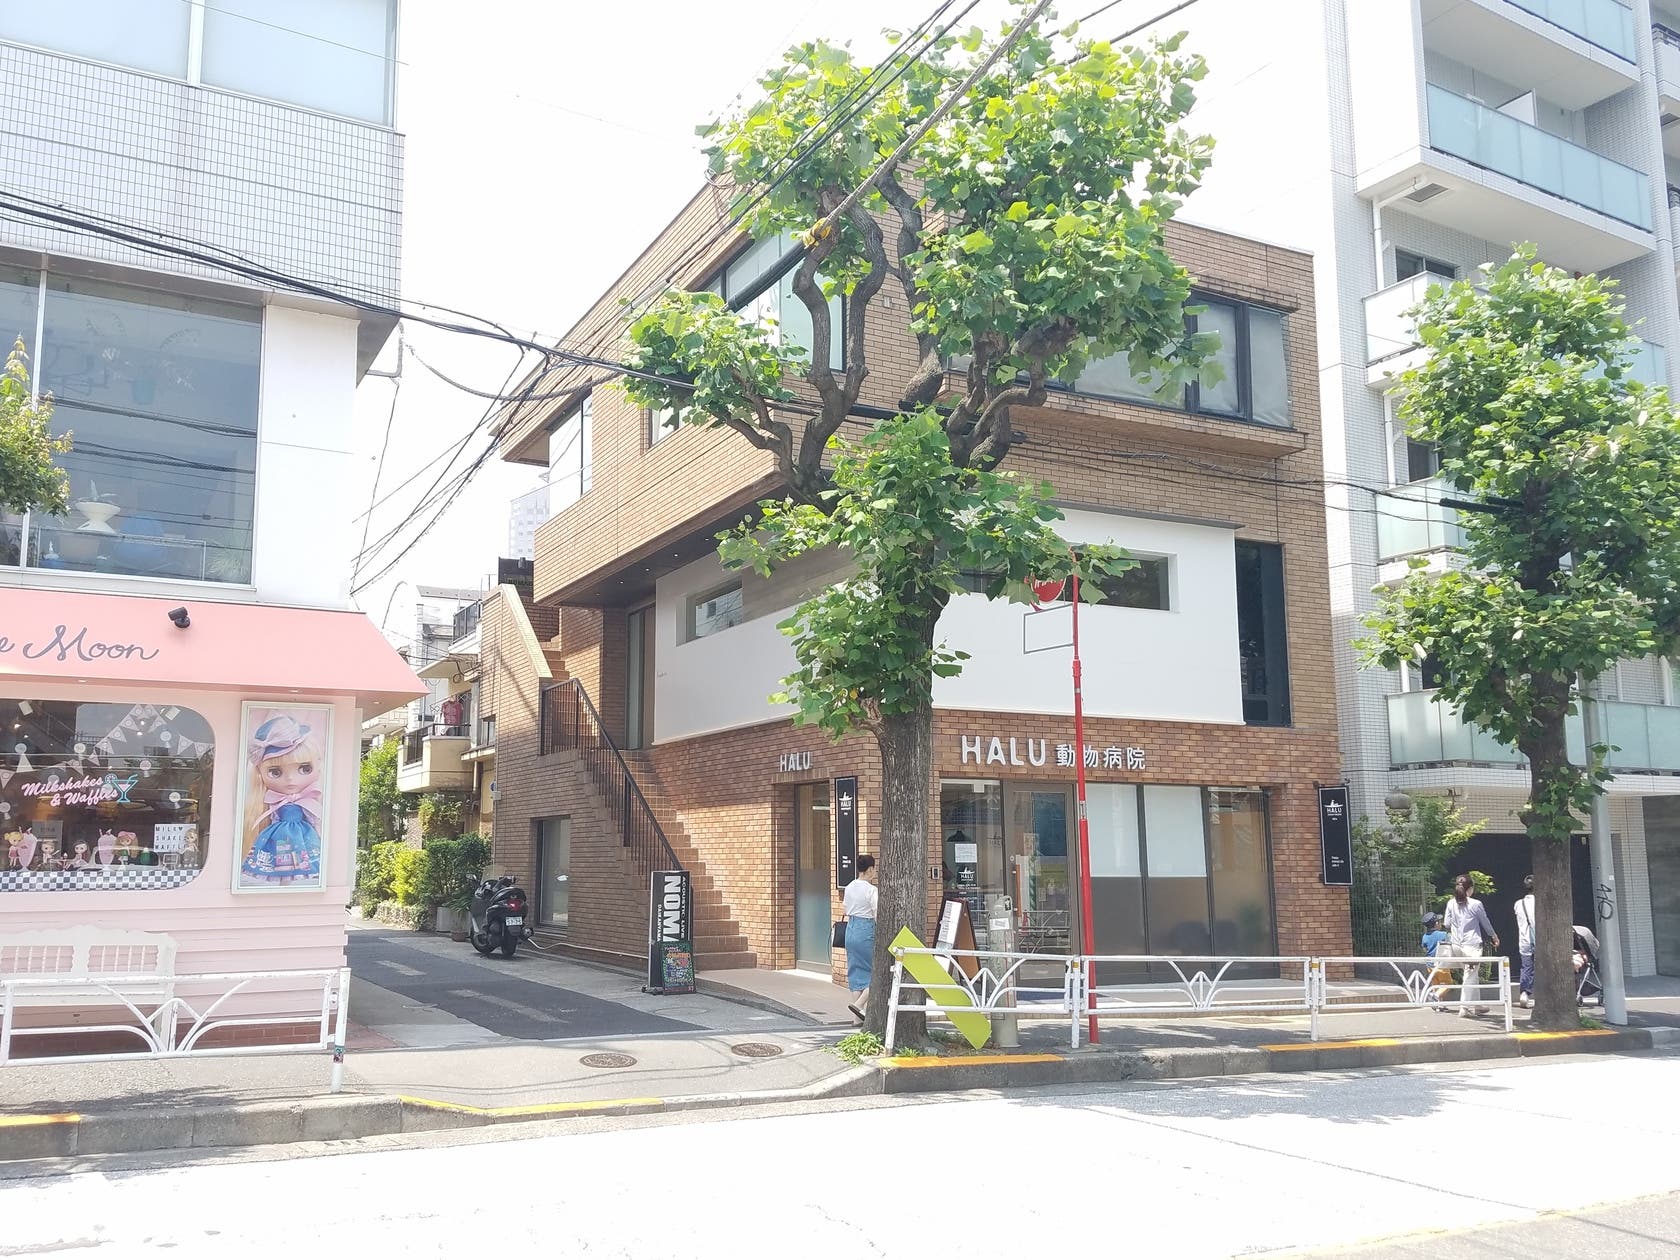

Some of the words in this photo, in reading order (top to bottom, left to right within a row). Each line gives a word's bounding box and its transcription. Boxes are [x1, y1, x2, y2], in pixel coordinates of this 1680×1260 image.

[22, 624, 160, 662] Moon
[780, 751, 811, 772] HALU
[961, 735, 1046, 767] HALU
[1056, 744, 1146, 770] 動物病院
[21, 774, 104, 796] Milkshakes
[50, 793, 61, 807] &
[63, 786, 119, 806] Waffles
